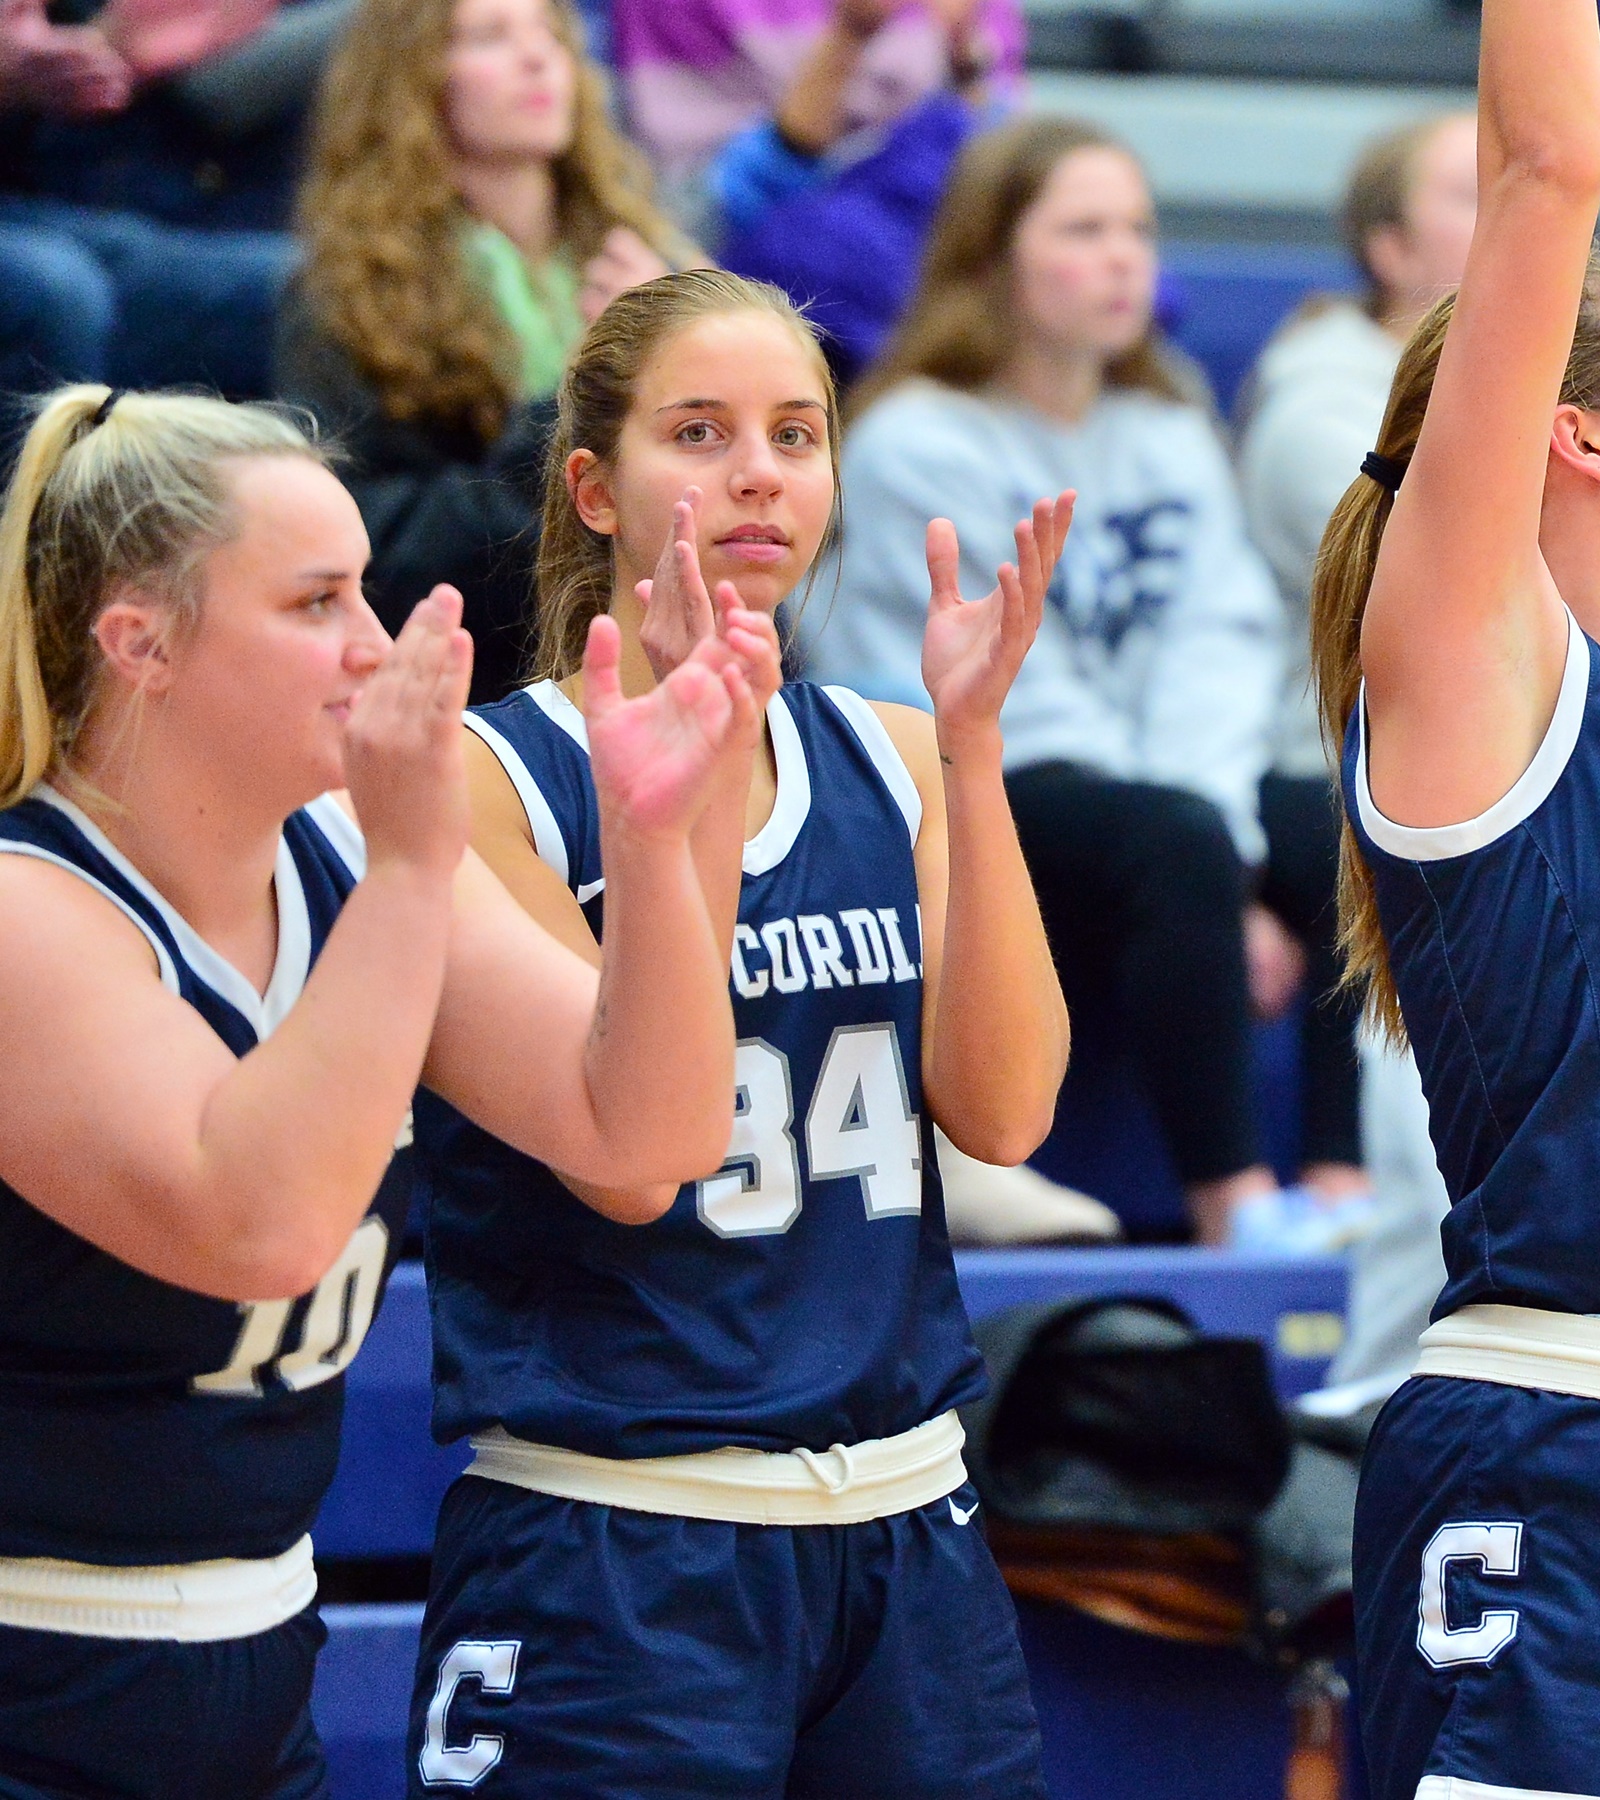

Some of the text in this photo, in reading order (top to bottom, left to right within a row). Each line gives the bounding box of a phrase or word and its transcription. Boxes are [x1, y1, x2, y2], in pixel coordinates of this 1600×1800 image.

[730, 907, 922, 1000] CORDI
[697, 1021, 922, 1239] 34
[1417, 1521, 1523, 1668] C
[419, 1640, 522, 1786] C
